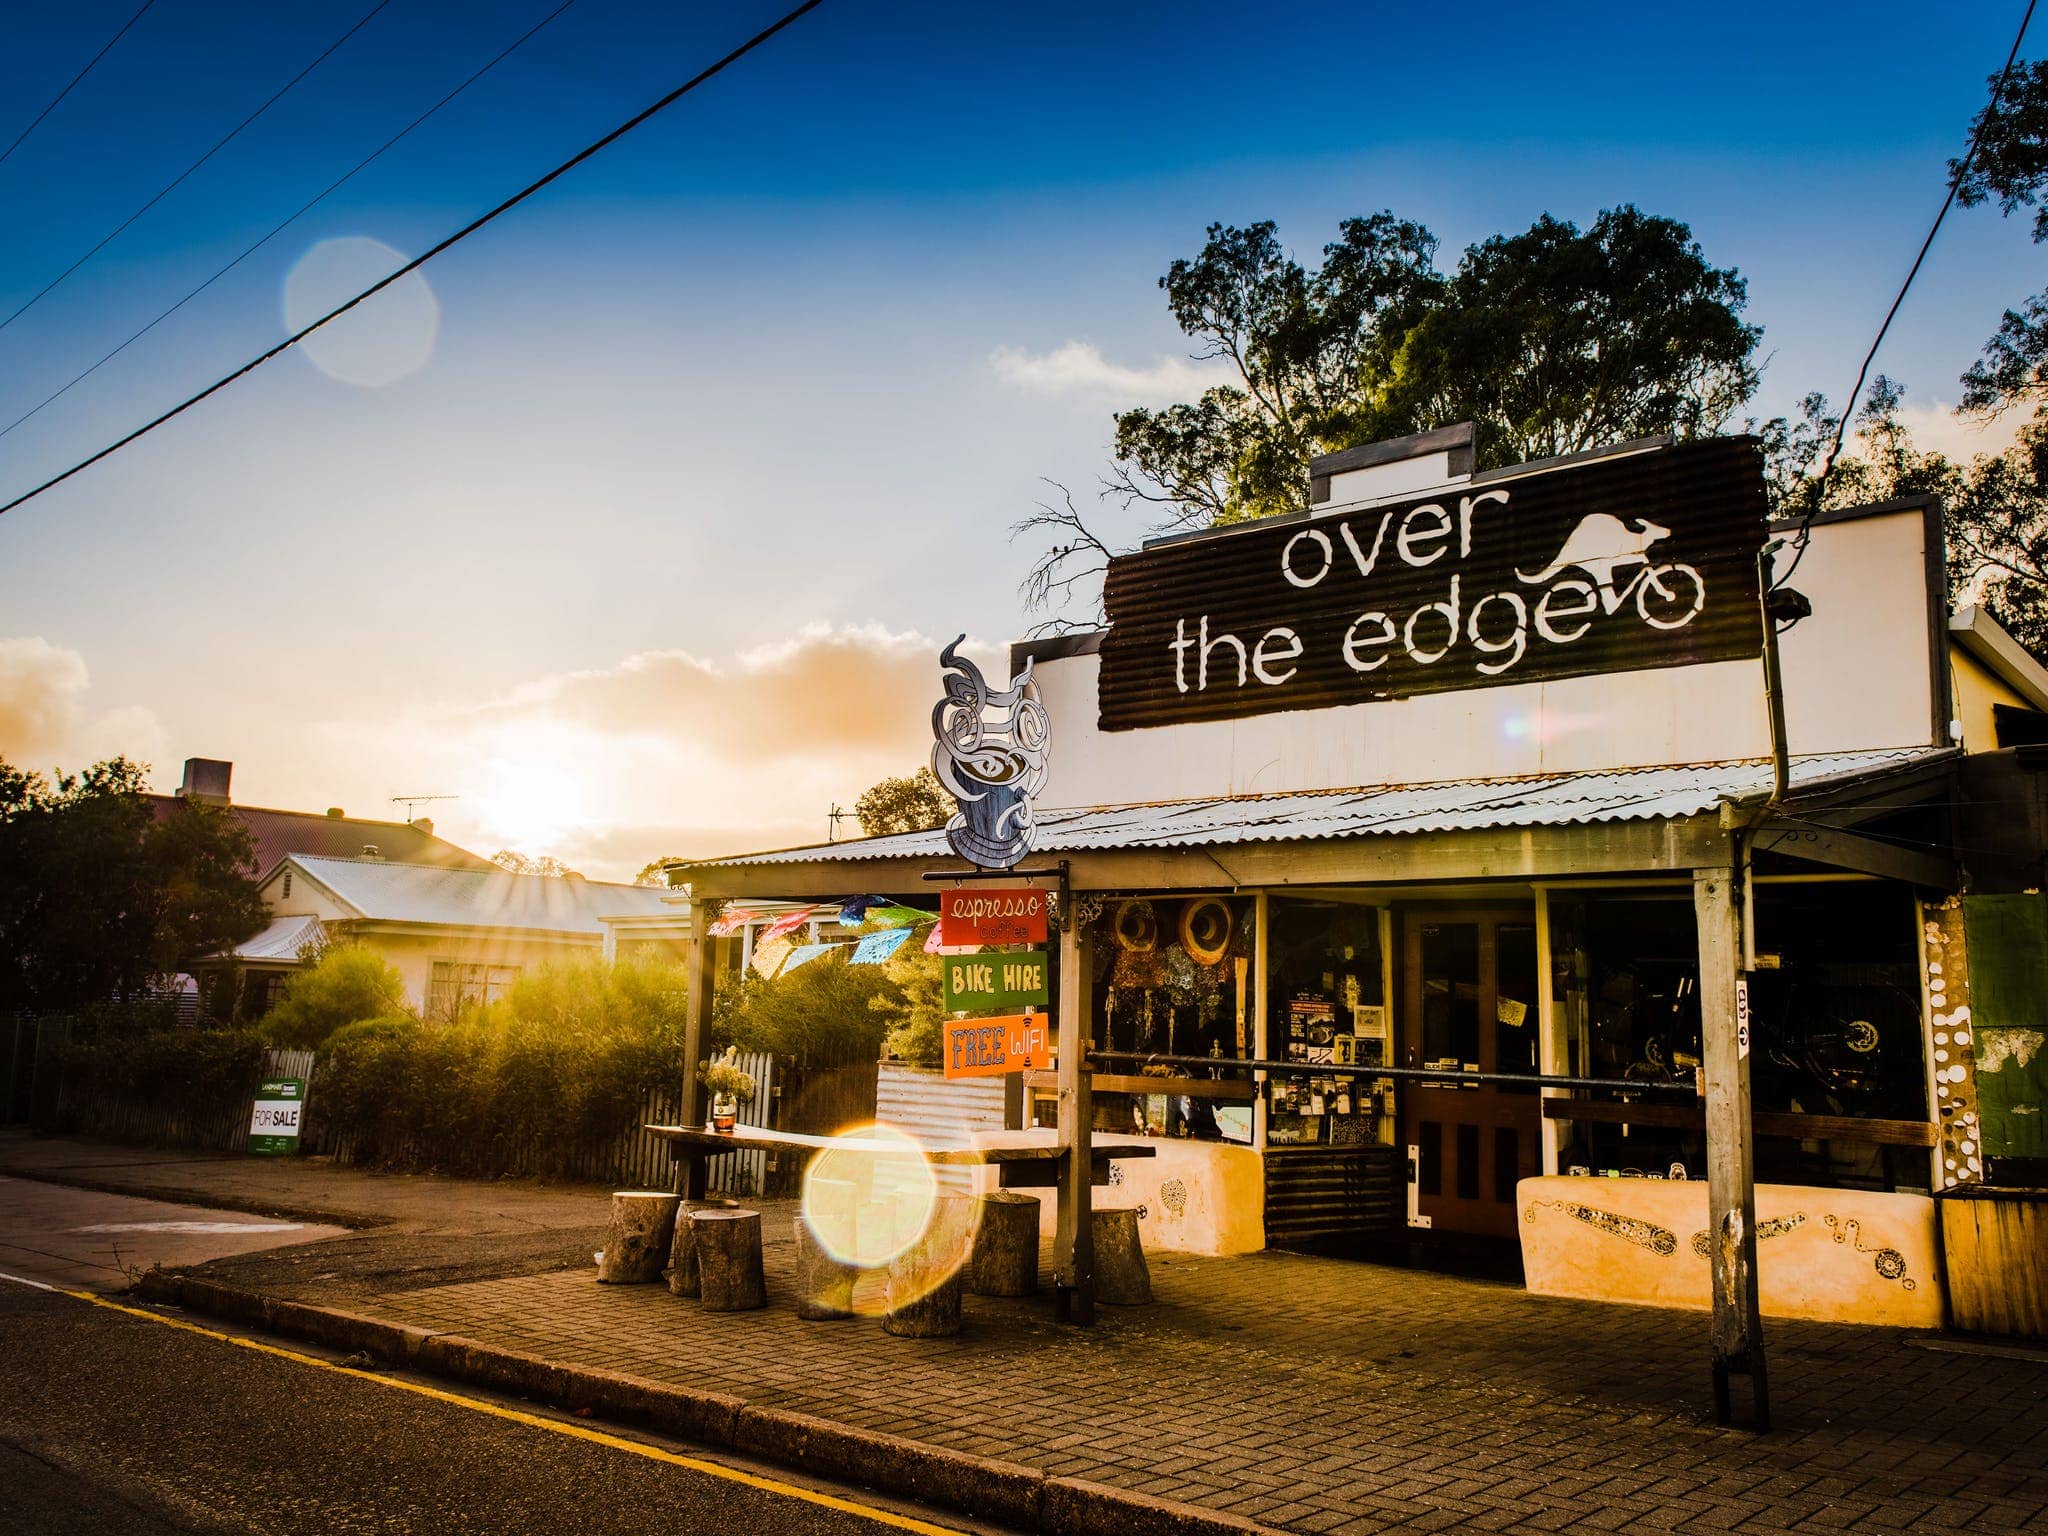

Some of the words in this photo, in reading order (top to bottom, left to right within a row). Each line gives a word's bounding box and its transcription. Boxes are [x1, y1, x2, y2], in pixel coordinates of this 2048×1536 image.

[1281, 489, 1510, 588] over
[1168, 615, 1304, 693] the
[1342, 573, 1598, 675] edge
[951, 896, 1043, 927] espresso
[979, 921, 1030, 939] coffee
[952, 963, 995, 995] BIKE
[1003, 964, 1042, 992] HIRE
[951, 1026, 1005, 1069] FREE
[1010, 1029, 1044, 1055] WIFI
[254, 1110, 271, 1126] FOR
[272, 1110, 298, 1127] SALE
